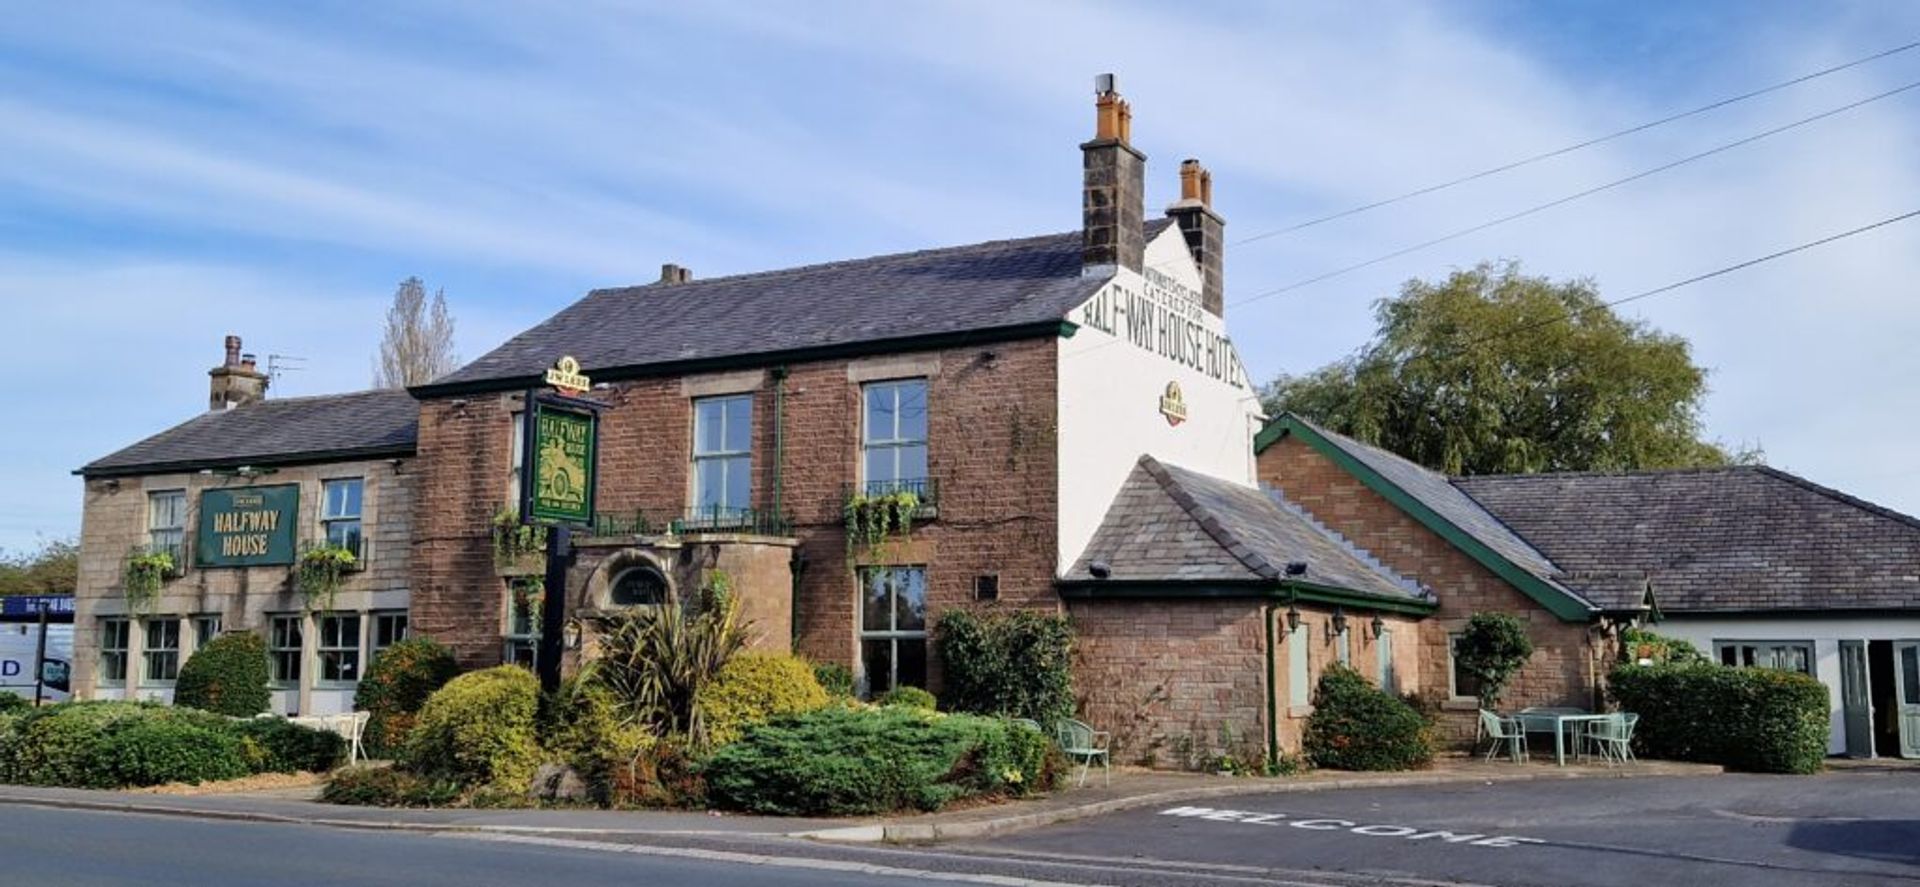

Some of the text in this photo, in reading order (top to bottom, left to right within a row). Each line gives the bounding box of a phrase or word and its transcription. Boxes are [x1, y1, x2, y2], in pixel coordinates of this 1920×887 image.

[1083, 284, 1154, 351] HALF-WAY
[1158, 306, 1203, 372] HOUSE
[1206, 329, 1244, 389] HOTEL
[541, 418, 586, 443] HALFWAY
[213, 510, 279, 533] HALFWAY
[222, 534, 268, 556] HOUSE
[1158, 806, 1547, 847] WELCOME
